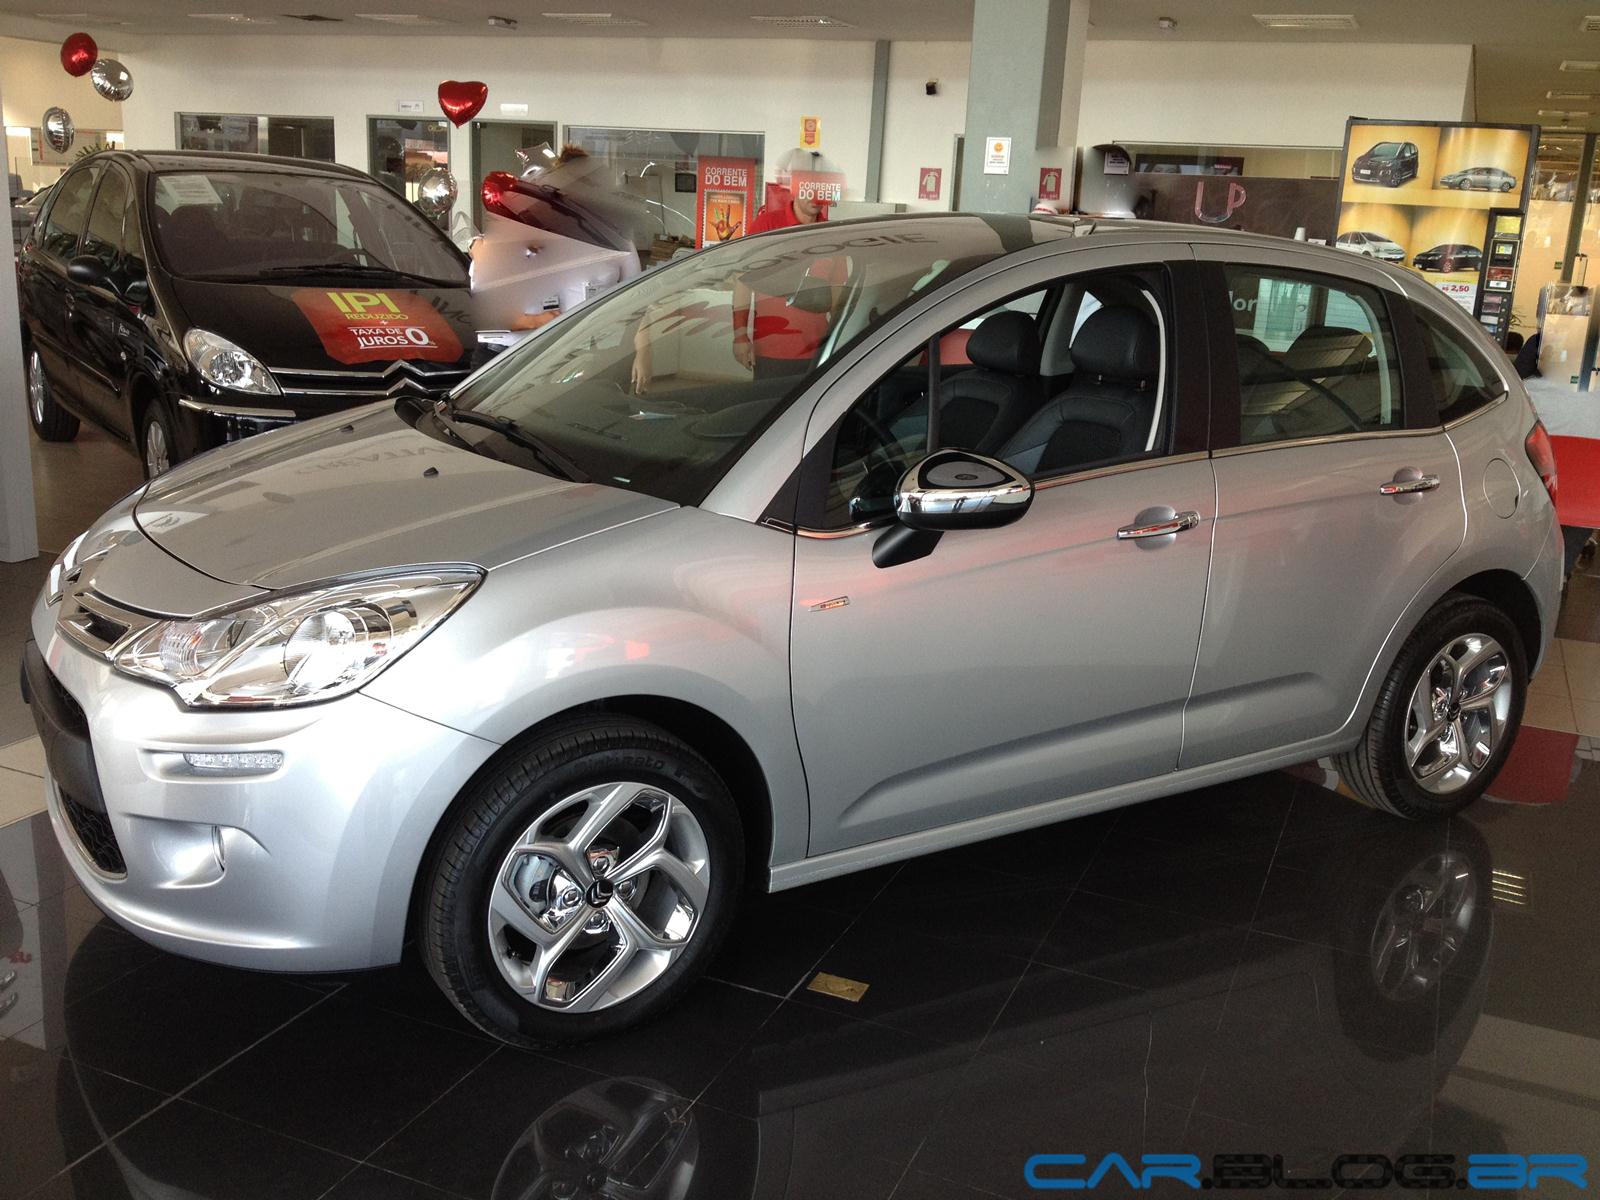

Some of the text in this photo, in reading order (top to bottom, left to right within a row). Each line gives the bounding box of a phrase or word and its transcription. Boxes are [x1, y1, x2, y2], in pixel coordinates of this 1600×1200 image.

[705, 166, 748, 177] CORRENTE
[704, 174, 747, 187] DO BEM
[799, 181, 841, 192] CORRENTE
[798, 189, 840, 201] DO BEM
[1450, 284, 1470, 293] 2,50
[326, 292, 401, 313] IPI
[350, 328, 384, 336] TAXA
[356, 335, 409, 348] JUROS
